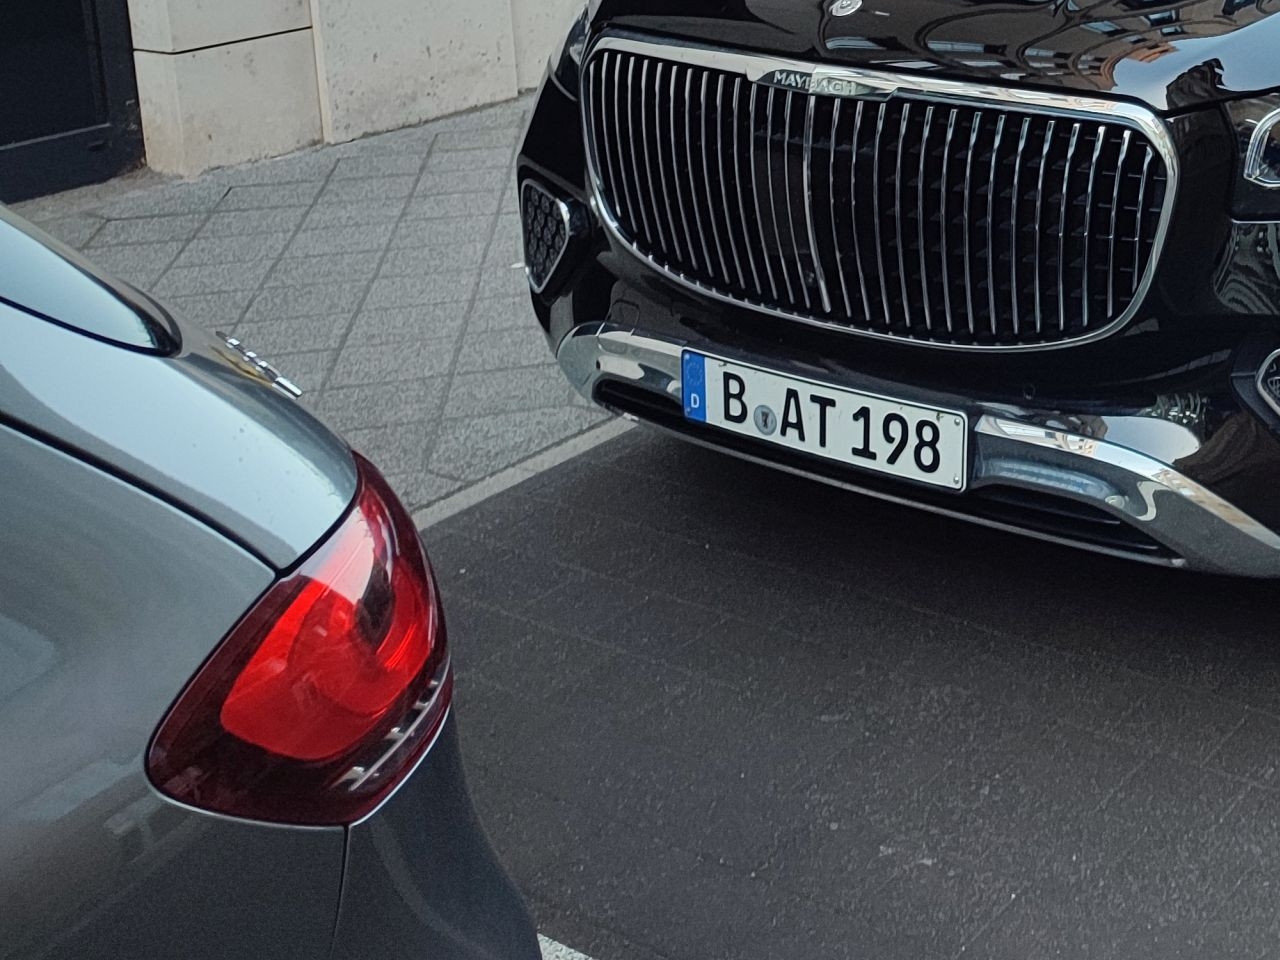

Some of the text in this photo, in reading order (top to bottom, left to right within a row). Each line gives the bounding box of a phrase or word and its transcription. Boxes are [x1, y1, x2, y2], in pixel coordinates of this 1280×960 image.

[773, 70, 857, 95] MAYBACH
[690, 393, 700, 408] D
[722, 371, 941, 474] B AT 198
